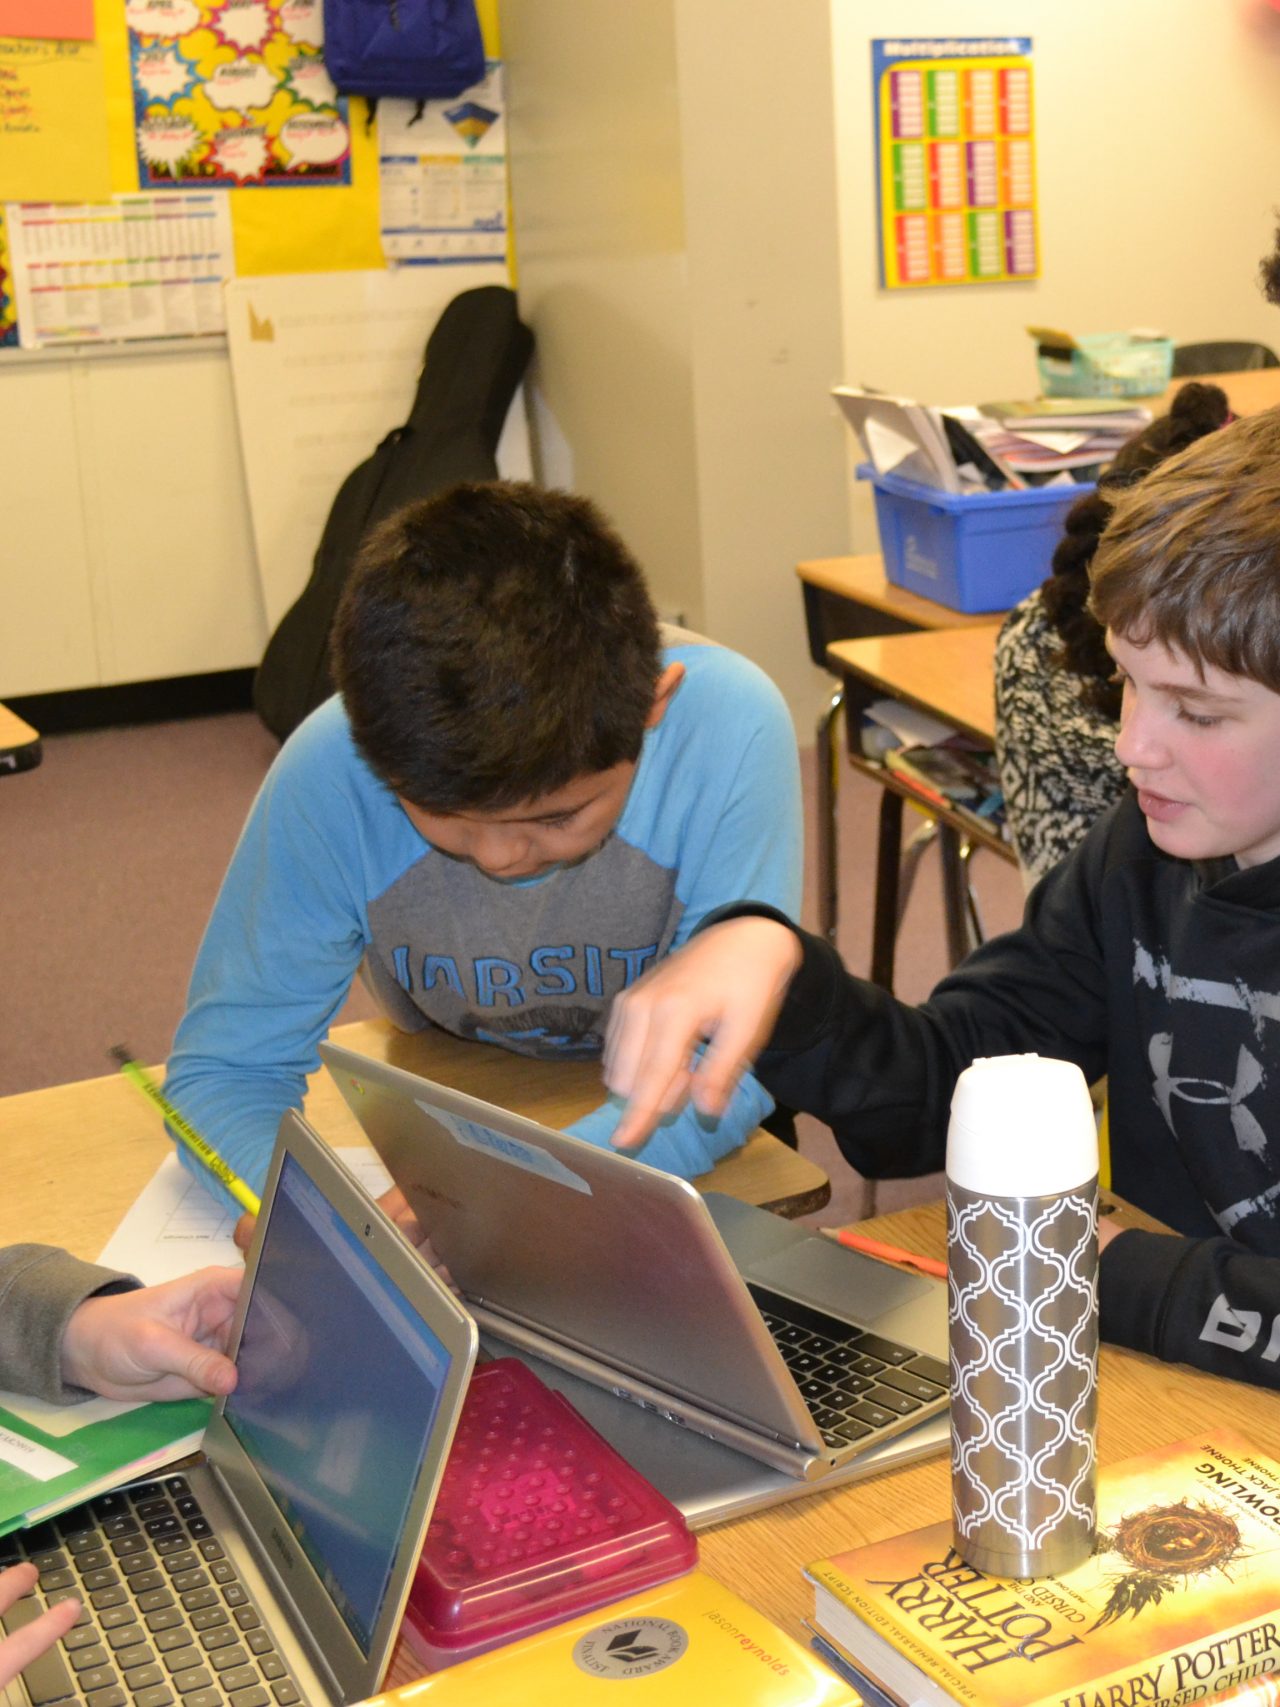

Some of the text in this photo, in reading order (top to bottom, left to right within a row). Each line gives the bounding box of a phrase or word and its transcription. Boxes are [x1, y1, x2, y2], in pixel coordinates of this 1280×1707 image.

[1200, 1444, 1247, 1475] THORNE
[1242, 1457, 1279, 1481] THORNE
[1246, 1474, 1276, 1494] JACK
[865, 1573, 1021, 1674] HARRY
[922, 1546, 1083, 1662] POTTER
[1032, 1587, 1085, 1623] CURSED
[581, 1640, 609, 1672] FINALIST
[601, 1619, 682, 1675] NATIONAL BOOK AWARD
[823, 1571, 977, 1699] SPECIAL REHEARSAL EDITION SCRIPT
[1143, 1657, 1276, 1707] RSED CHILD
